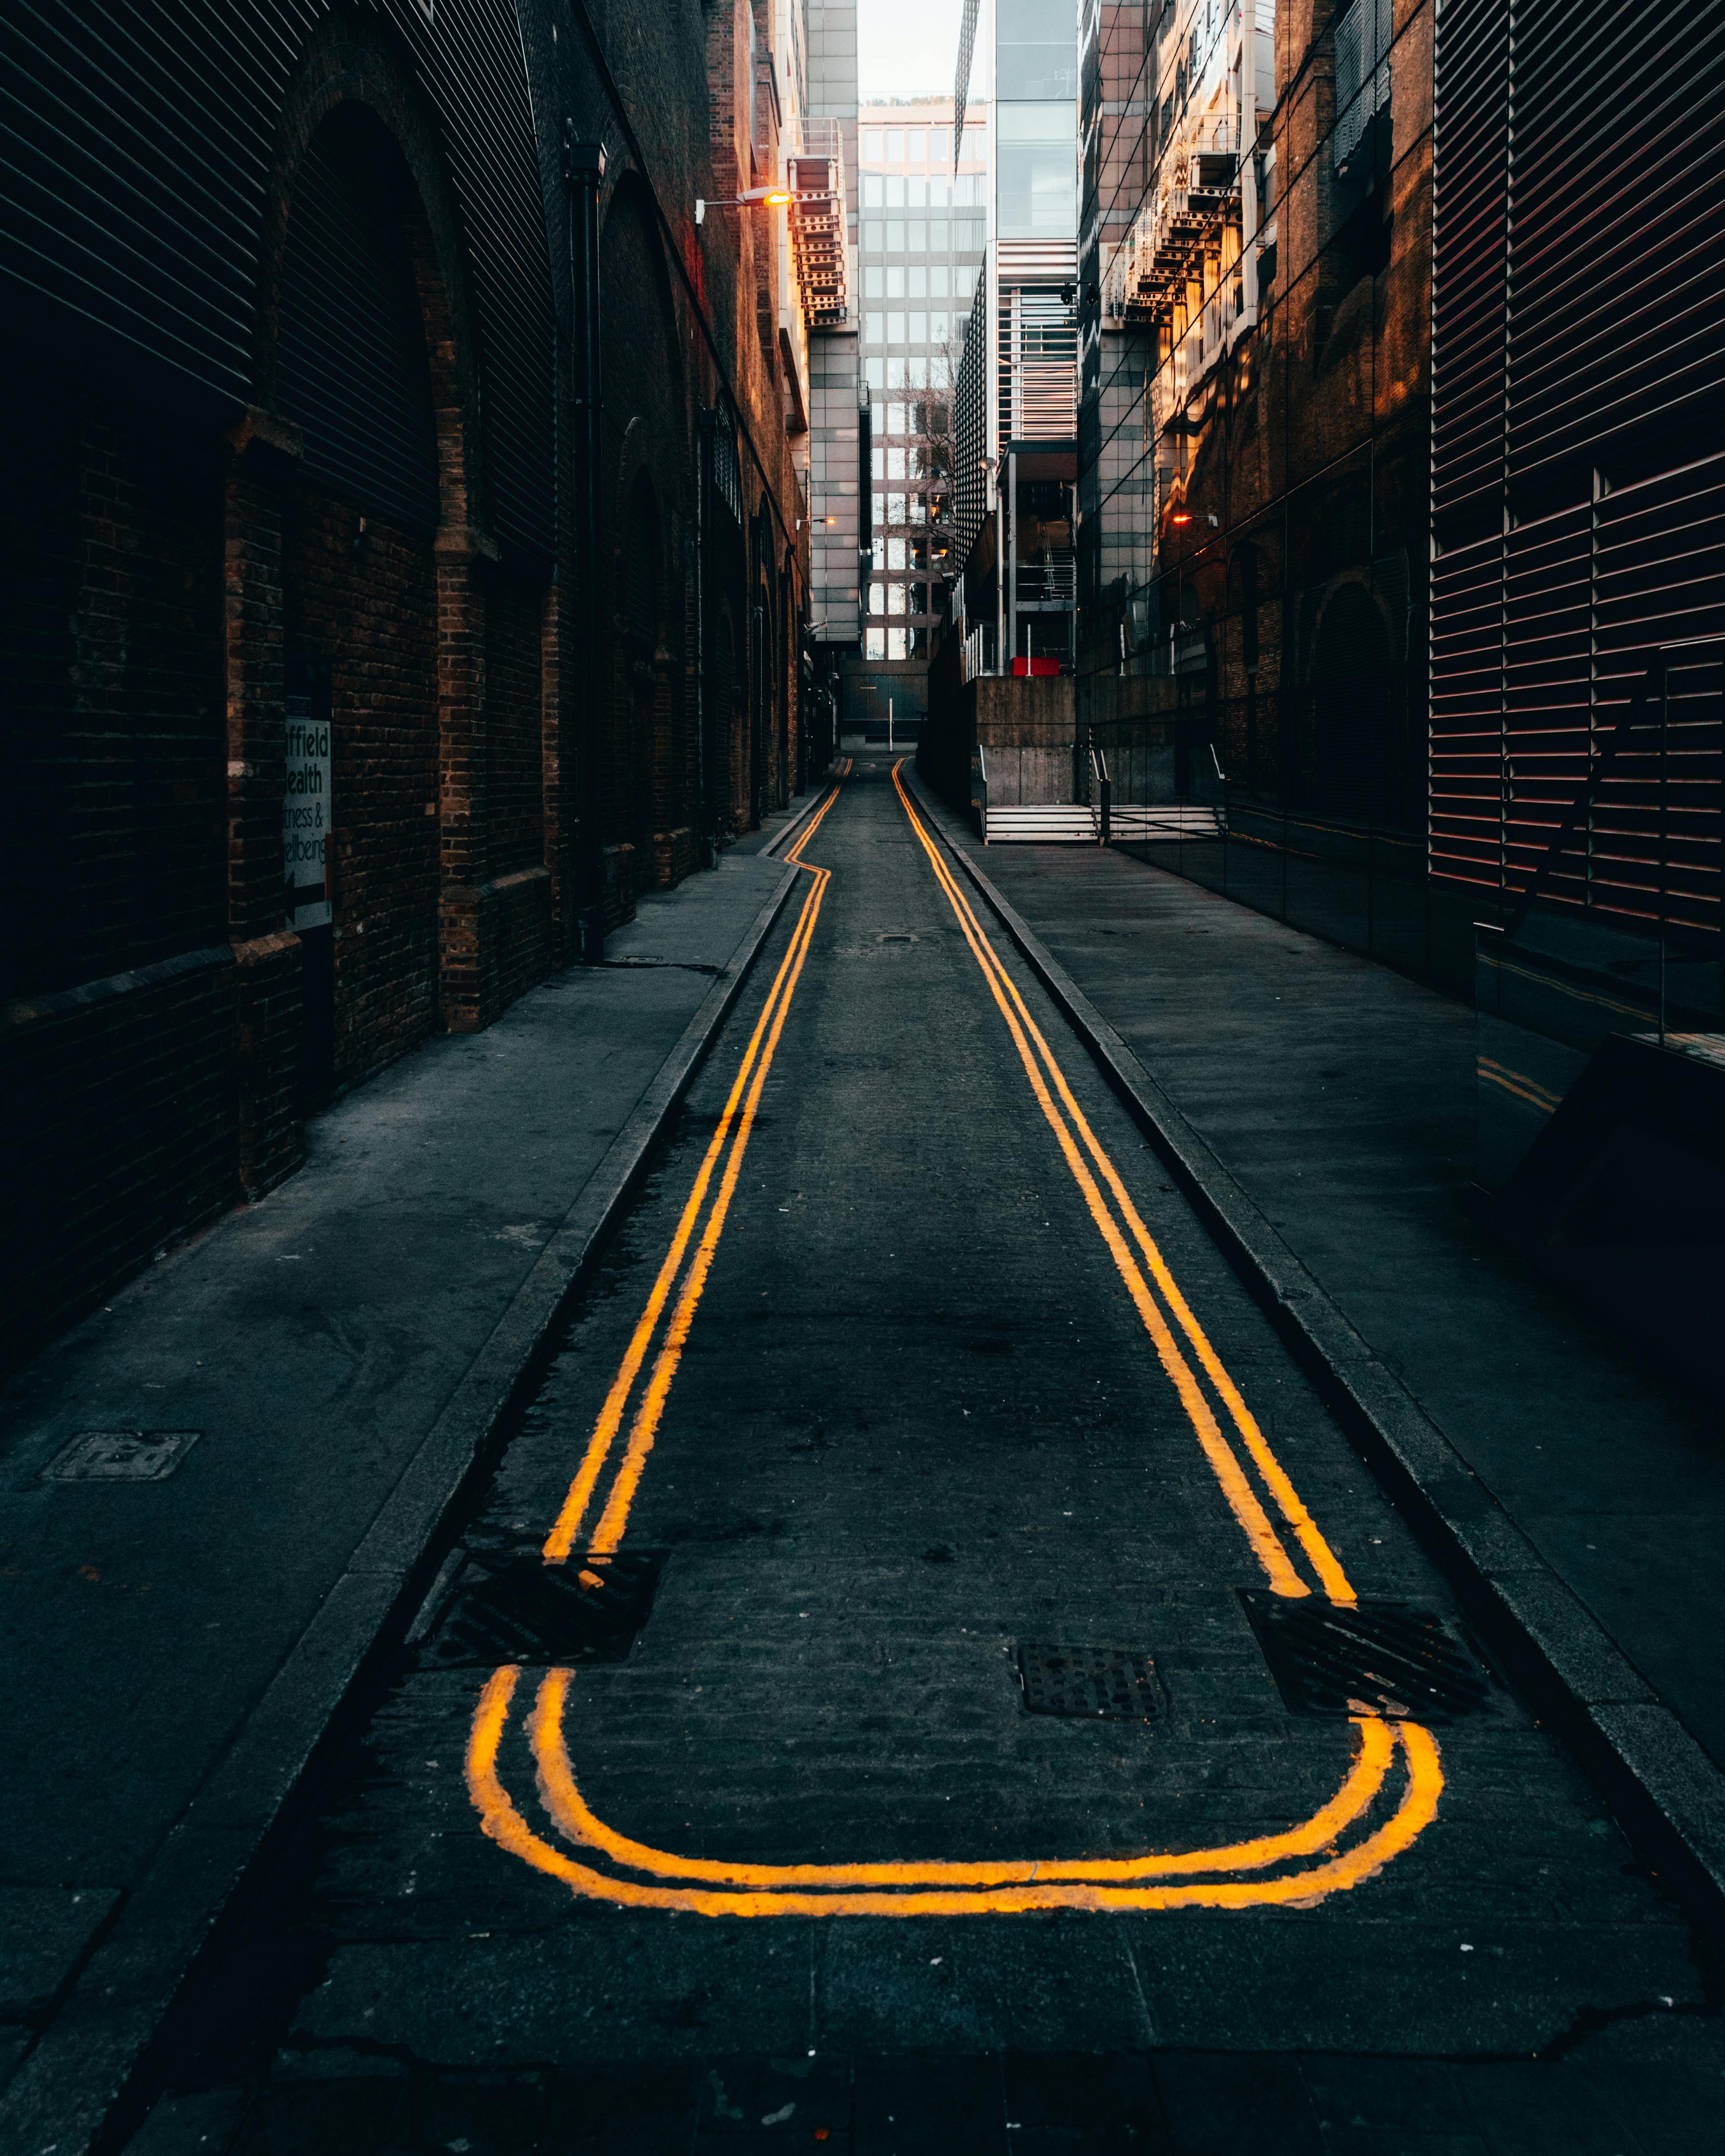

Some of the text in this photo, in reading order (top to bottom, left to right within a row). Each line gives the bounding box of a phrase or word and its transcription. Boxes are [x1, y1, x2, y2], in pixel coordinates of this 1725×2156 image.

[284, 763, 322, 795] ealth
[315, 802, 323, 828] &
[283, 832, 326, 865] ellbeing
